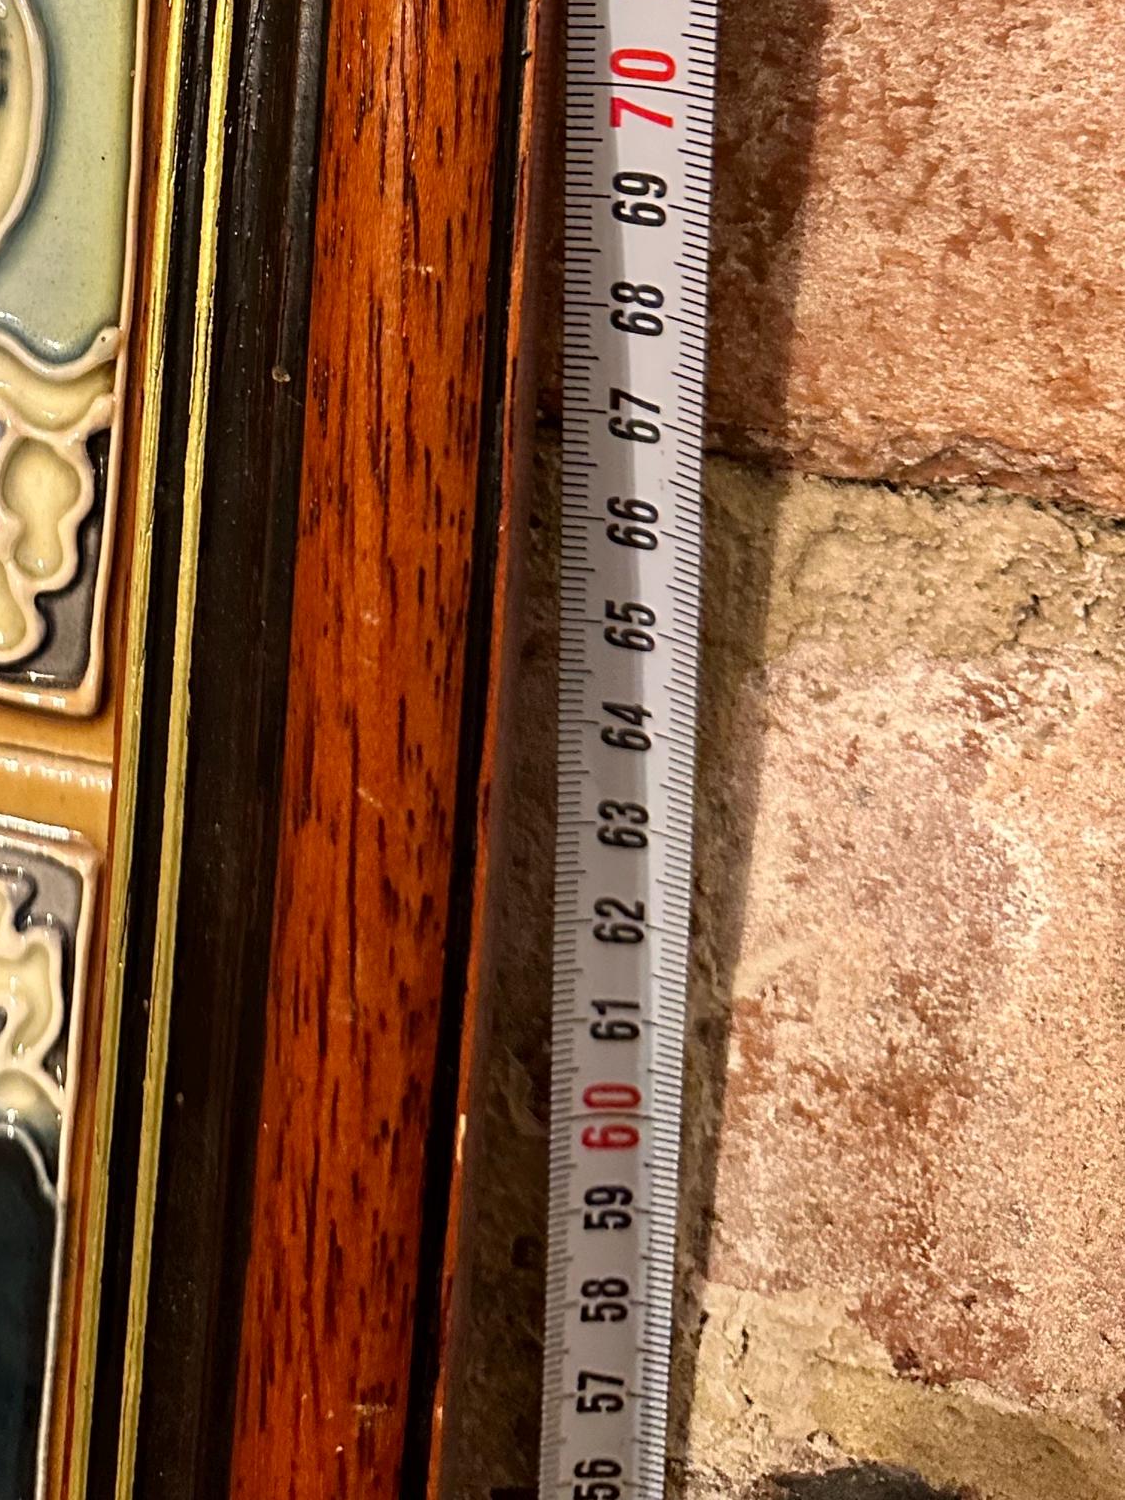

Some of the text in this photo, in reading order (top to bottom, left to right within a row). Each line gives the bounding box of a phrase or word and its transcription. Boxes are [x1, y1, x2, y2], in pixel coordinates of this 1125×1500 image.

[609, 48, 677, 129] 70
[611, 171, 668, 227] 69
[609, 282, 665, 337] 68
[608, 388, 662, 444] 67
[606, 496, 659, 550] 66
[604, 600, 657, 651] 65
[601, 701, 653, 752] 64
[597, 800, 650, 849] 63
[593, 896, 646, 945] 62
[590, 997, 640, 1042] 61
[581, 1082, 641, 1150] 60
[583, 1184, 634, 1232] 59
[581, 1276, 630, 1323] 58
[576, 1371, 624, 1414] 57
[573, 1458, 622, 1500] 56
